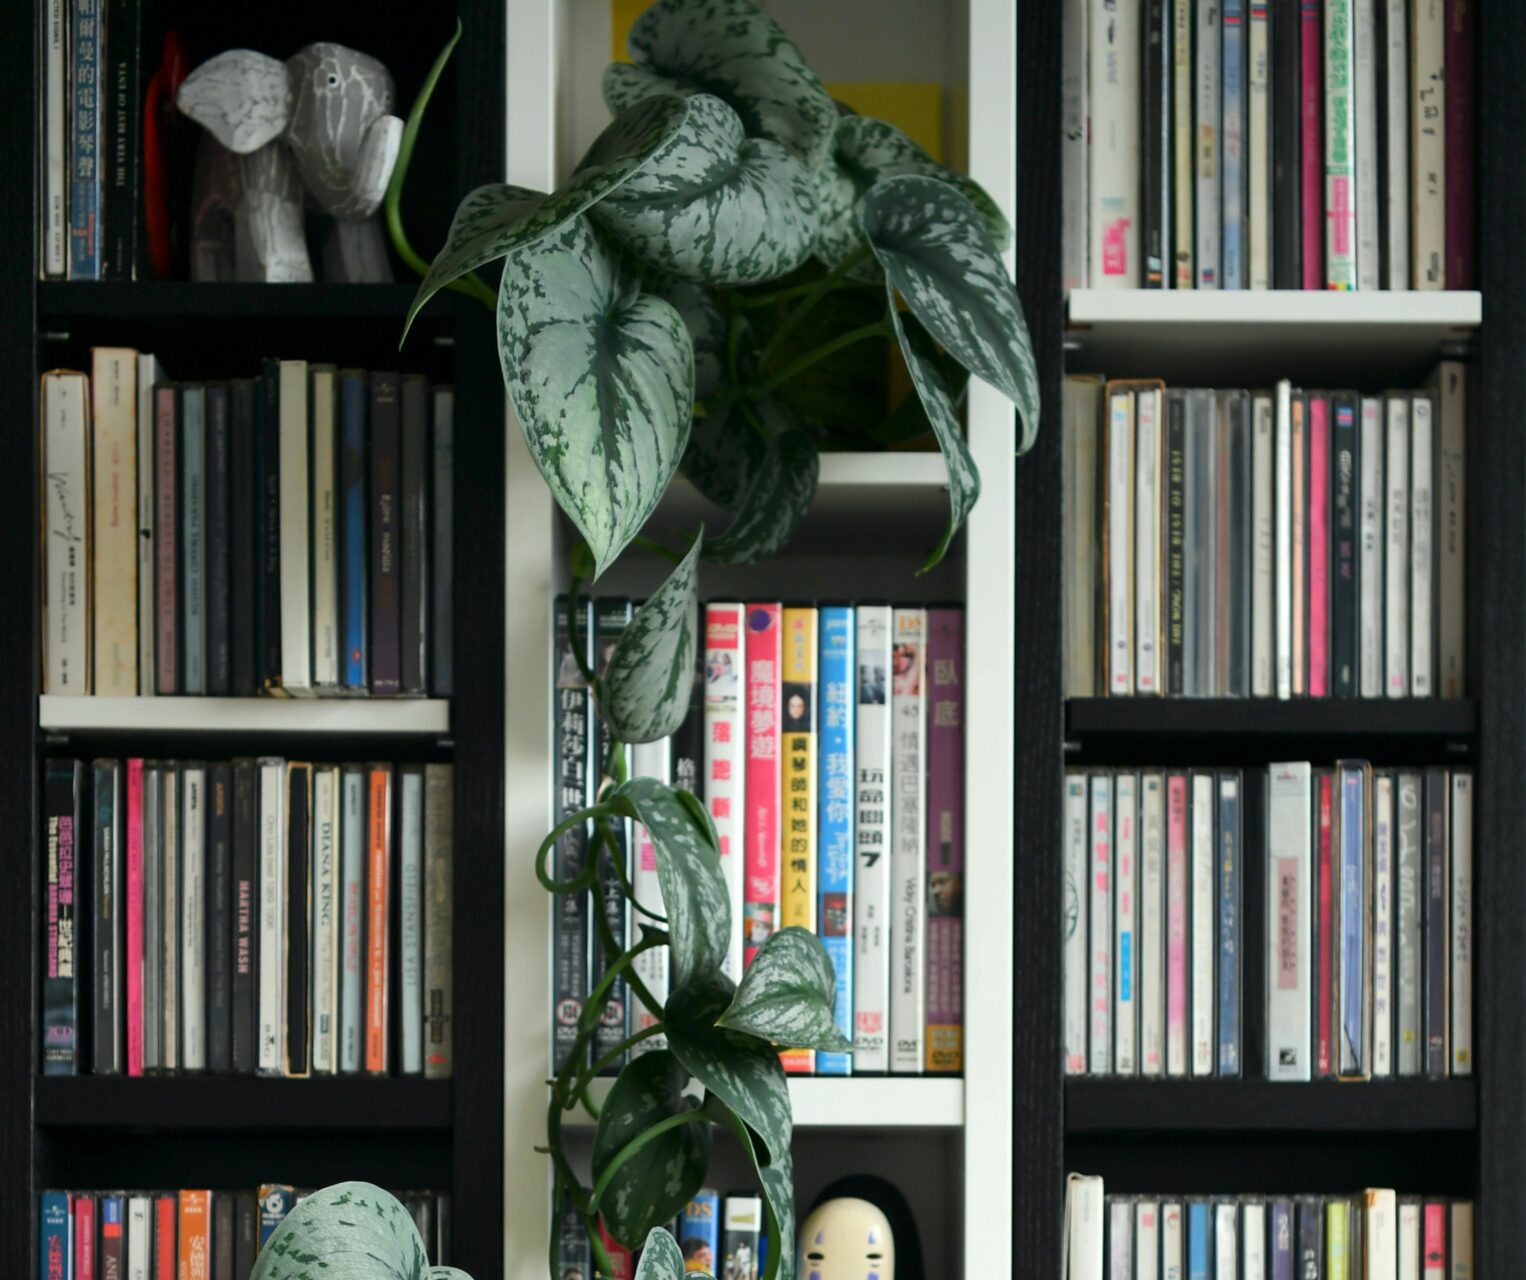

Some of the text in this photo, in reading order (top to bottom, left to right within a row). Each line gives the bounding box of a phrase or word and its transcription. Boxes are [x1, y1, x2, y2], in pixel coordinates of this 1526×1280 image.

[116, 62, 127, 186] THE VERY BEST OF ENYA
[48, 816, 58, 836] The
[48, 837, 58, 884] Essential
[320, 822, 330, 927] DIANA KING
[238, 880, 250, 974] MARTHA WASH
[404, 864, 416, 986] LISA STANSFIELD
[903, 877, 917, 995] Vicky Cristina Barcelona
